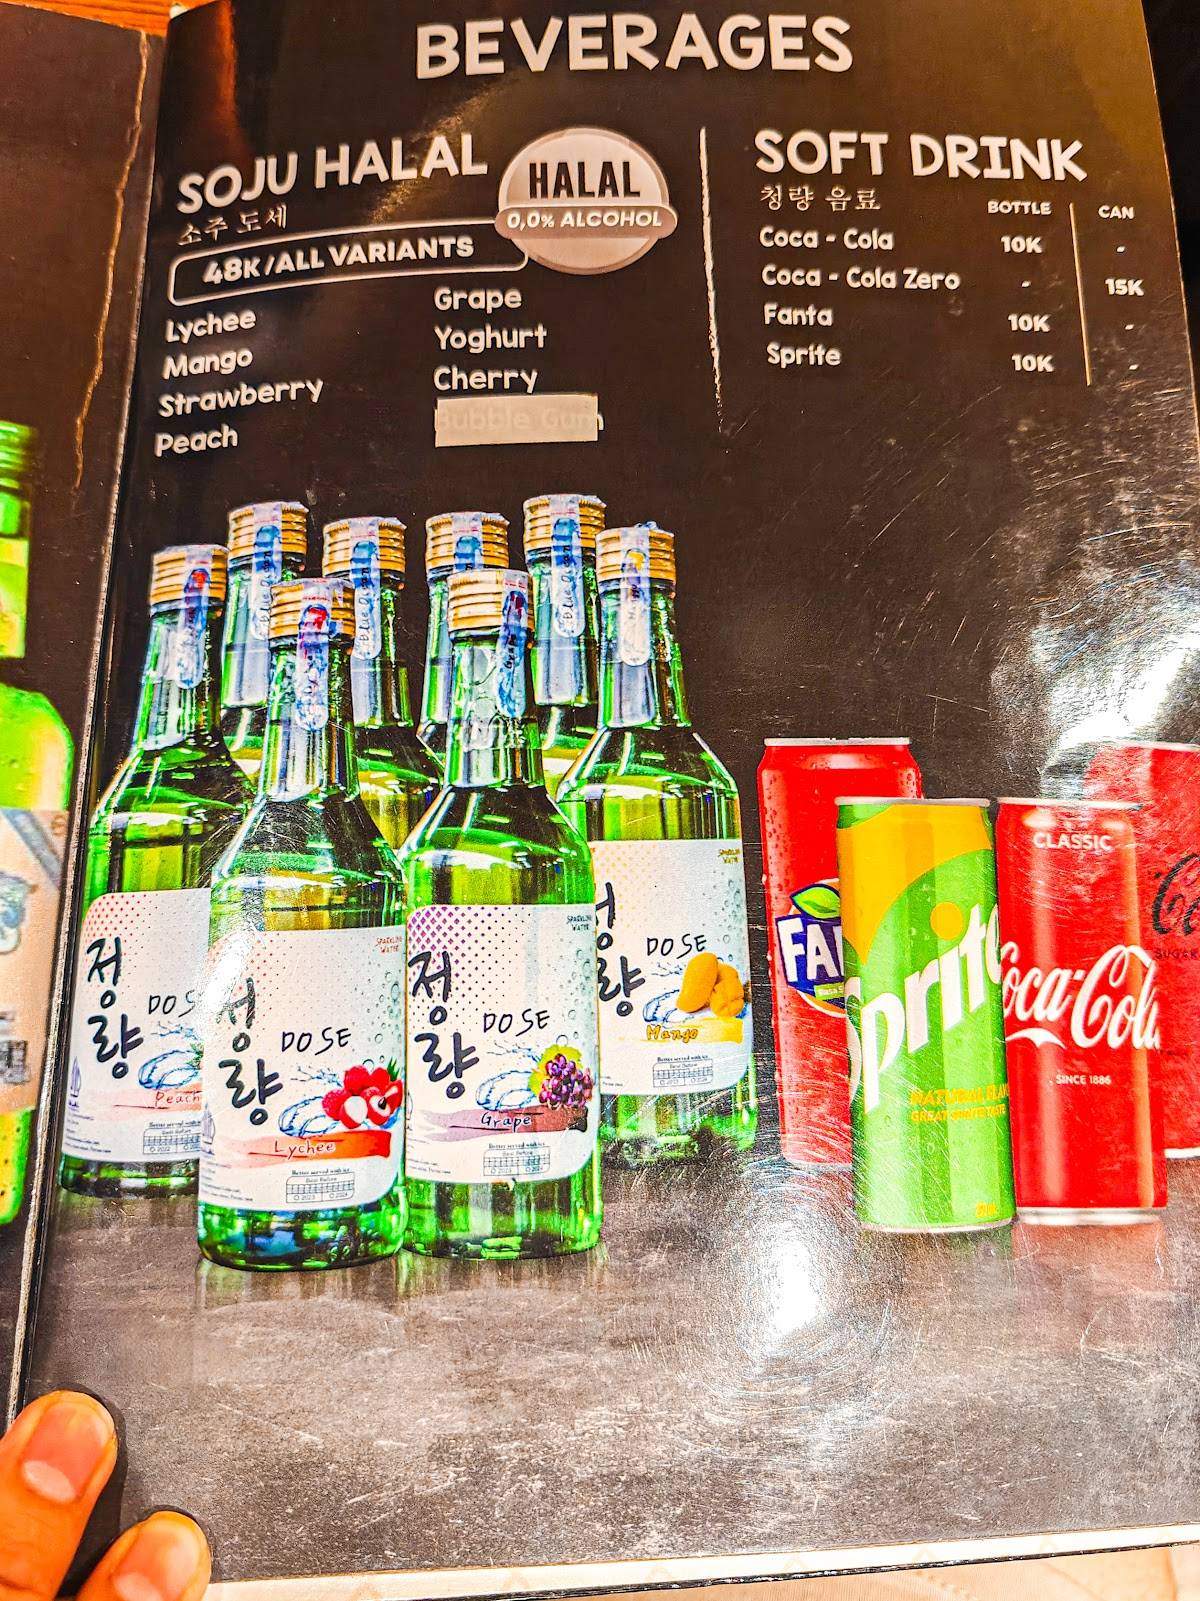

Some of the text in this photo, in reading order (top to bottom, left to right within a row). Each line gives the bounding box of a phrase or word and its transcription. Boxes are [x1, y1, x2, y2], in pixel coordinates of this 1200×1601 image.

[417, 14, 852, 78] BEVERAGES
[755, 130, 1087, 181] SOFT DRINK
[178, 132, 488, 214] SOJU HALAL
[530, 161, 640, 199] HALAL
[761, 185, 880, 211] 청량 음료
[988, 201, 1051, 214] BOTTLE
[507, 211, 662, 231] 0,0% ALCOHOL
[1099, 205, 1134, 219] CAN
[178, 216, 228, 246] 소주
[760, 226, 818, 248] Coca
[844, 228, 893, 249] Cola
[331, 235, 475, 268] VARIANTS
[1001, 236, 1042, 253] 10K
[762, 265, 821, 286] Coca
[847, 267, 896, 288] Cola
[903, 268, 960, 289] Zero
[1105, 279, 1144, 295] 15K
[435, 288, 521, 313] Grape
[167, 310, 256, 343] Lychee
[764, 303, 832, 326] Fanta
[1008, 314, 1050, 331] 10K
[435, 324, 546, 353] Yoghurt
[163, 349, 252, 379] Mango
[767, 343, 840, 368] Sprite
[1012, 354, 1054, 372] 10K
[434, 366, 537, 393] Cherry
[160, 378, 323, 417] Strawberry
[156, 424, 237, 456] Peach
[1033, 832, 1113, 851] CLASSIC
[647, 934, 707, 959] DOSE
[484, 1009, 550, 1036] DOSE
[646, 1024, 698, 1043] Mango
[282, 1027, 351, 1055] DOSE
[1056, 1074, 1112, 1085] SINCE 1886
[481, 1112, 532, 1132] Grape
[274, 1139, 335, 1160] Lychee
